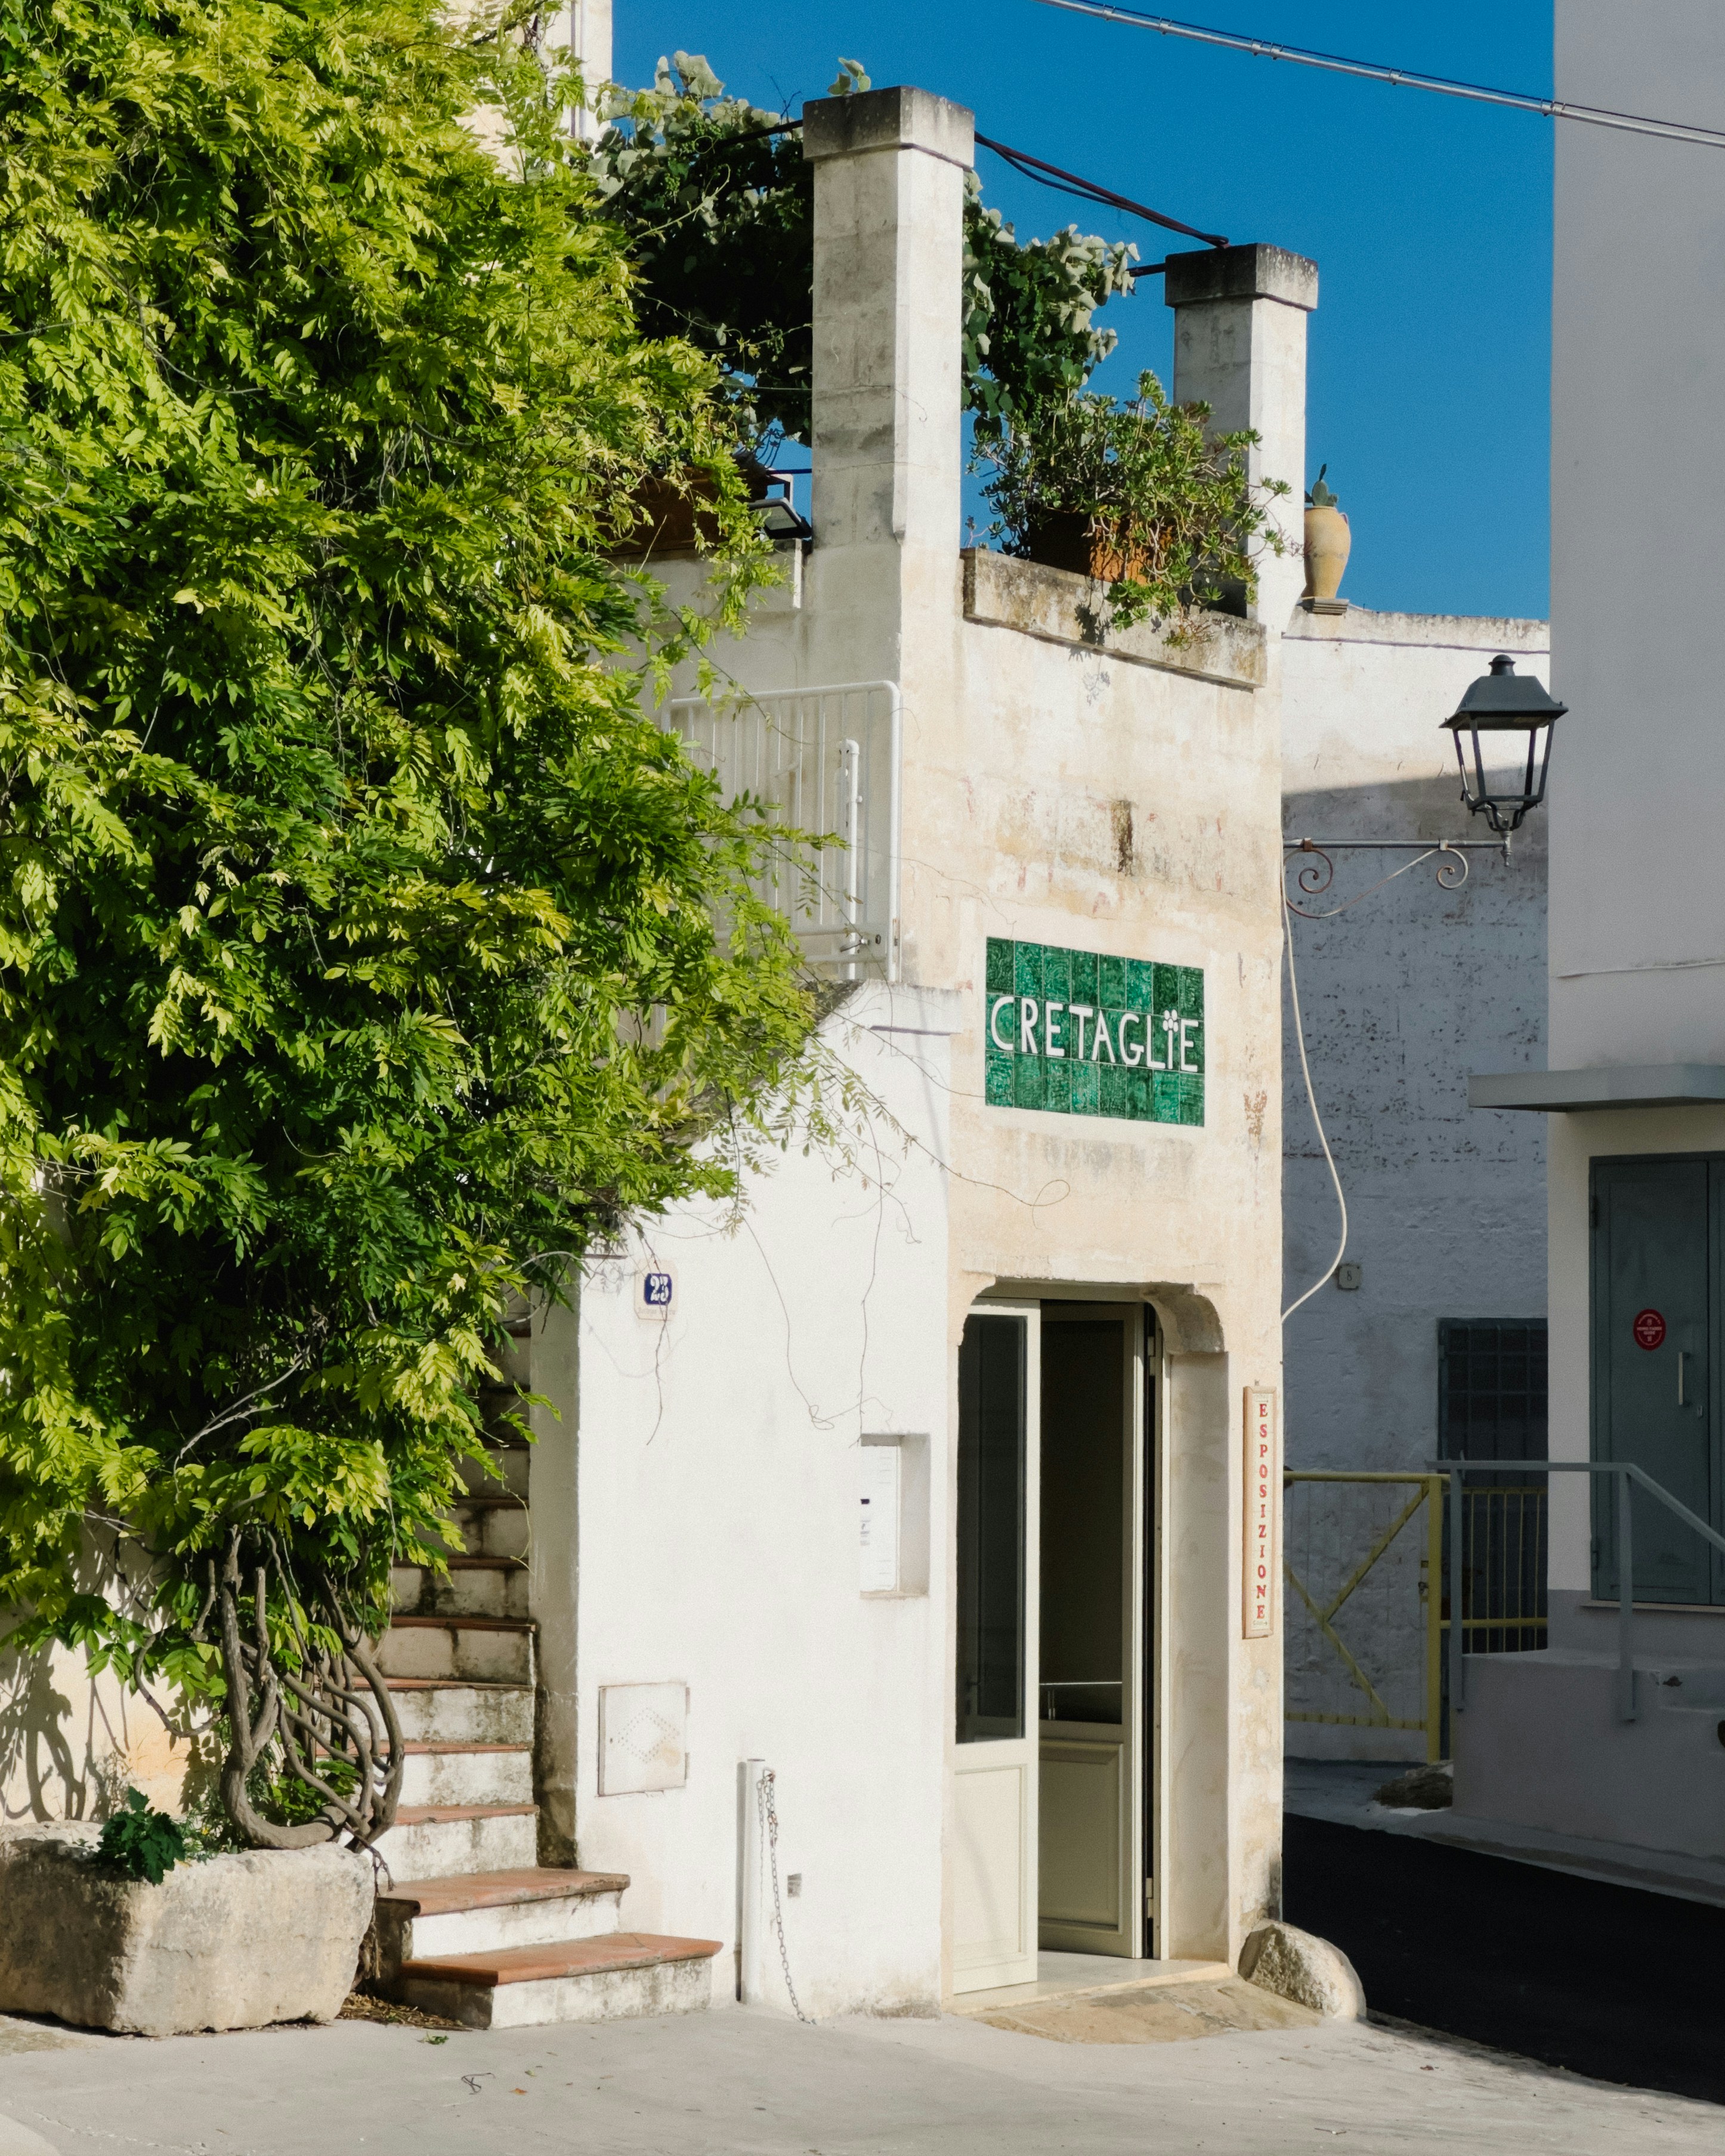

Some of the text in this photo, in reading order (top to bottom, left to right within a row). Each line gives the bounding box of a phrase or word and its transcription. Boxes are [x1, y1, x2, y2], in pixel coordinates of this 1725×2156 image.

[991, 996, 1199, 1073] CRETAGLIE
[650, 1275, 669, 1302] 23
[1256, 1403, 1268, 1619] ESPOSIZIONE
